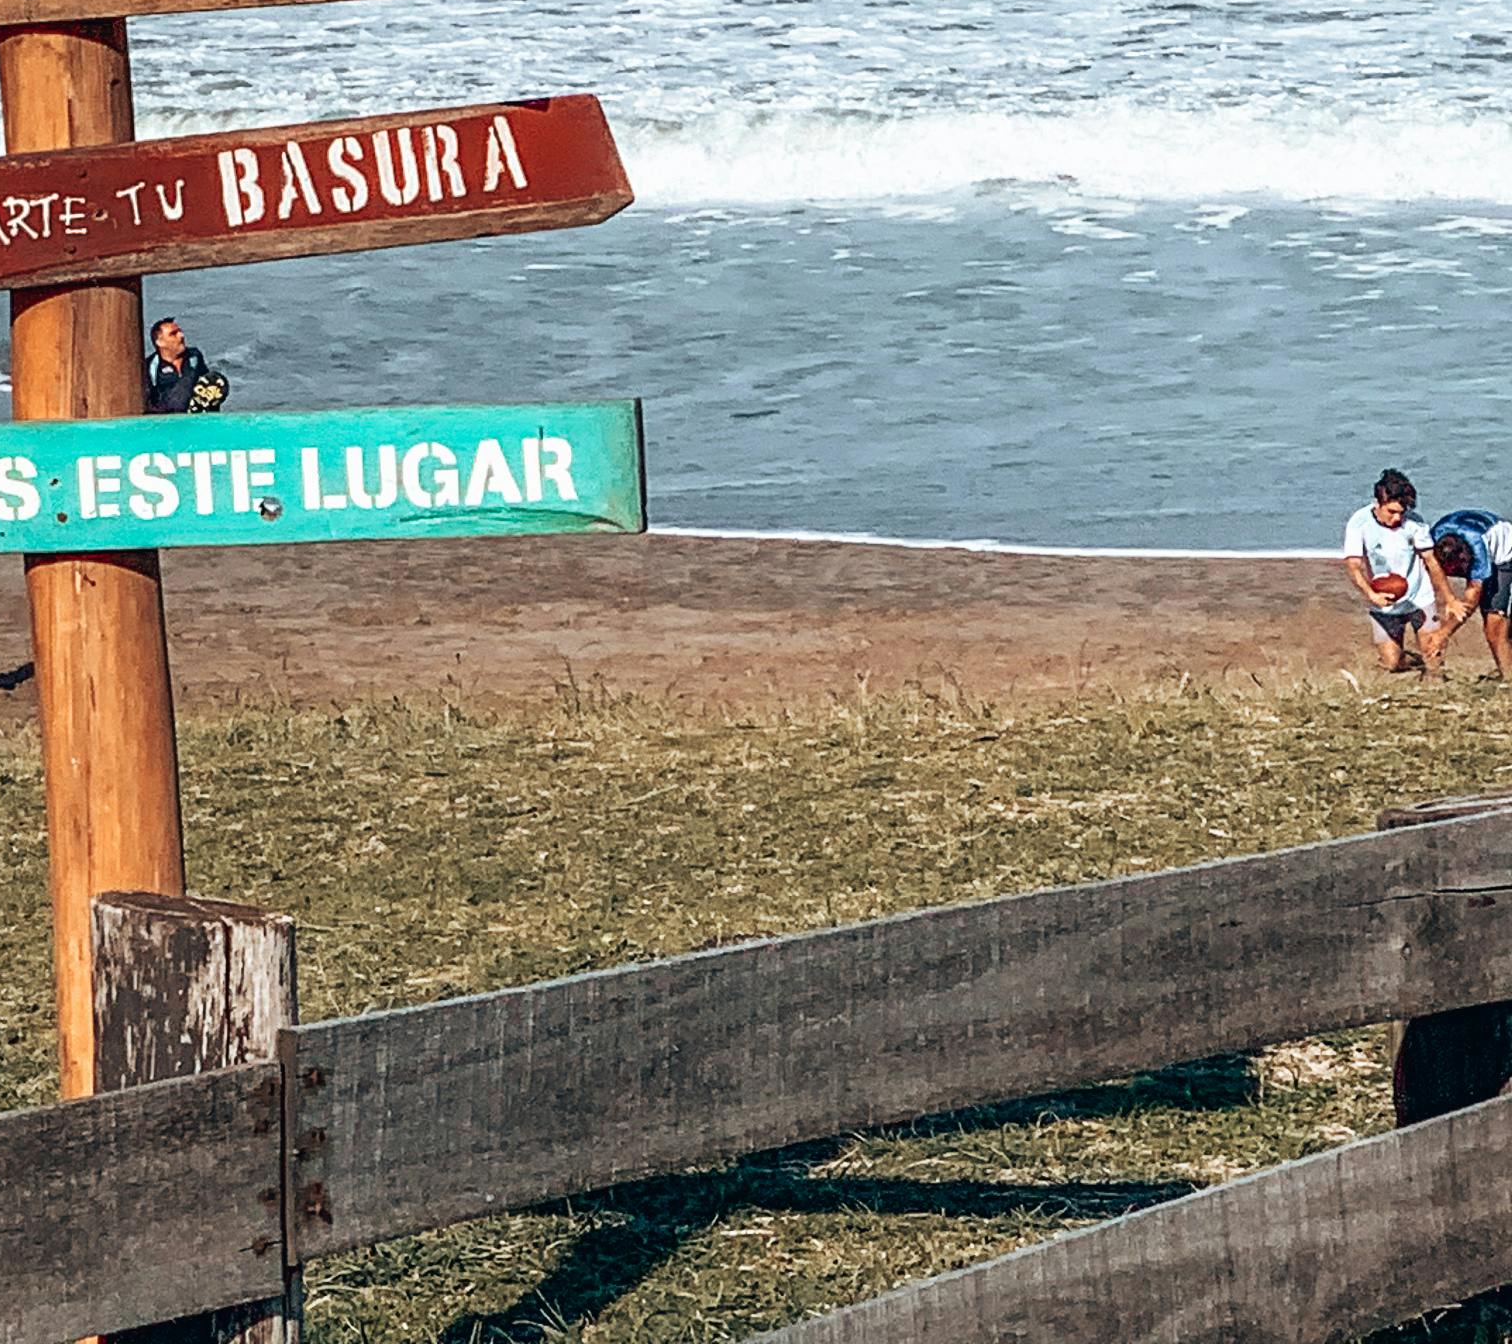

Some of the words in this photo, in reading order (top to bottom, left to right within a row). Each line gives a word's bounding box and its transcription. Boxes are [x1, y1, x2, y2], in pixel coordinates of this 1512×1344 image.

[115, 179, 185, 226] TU
[218, 114, 528, 228] BASURA
[76, 447, 280, 521] ESTE
[300, 436, 580, 511] LUGAR
